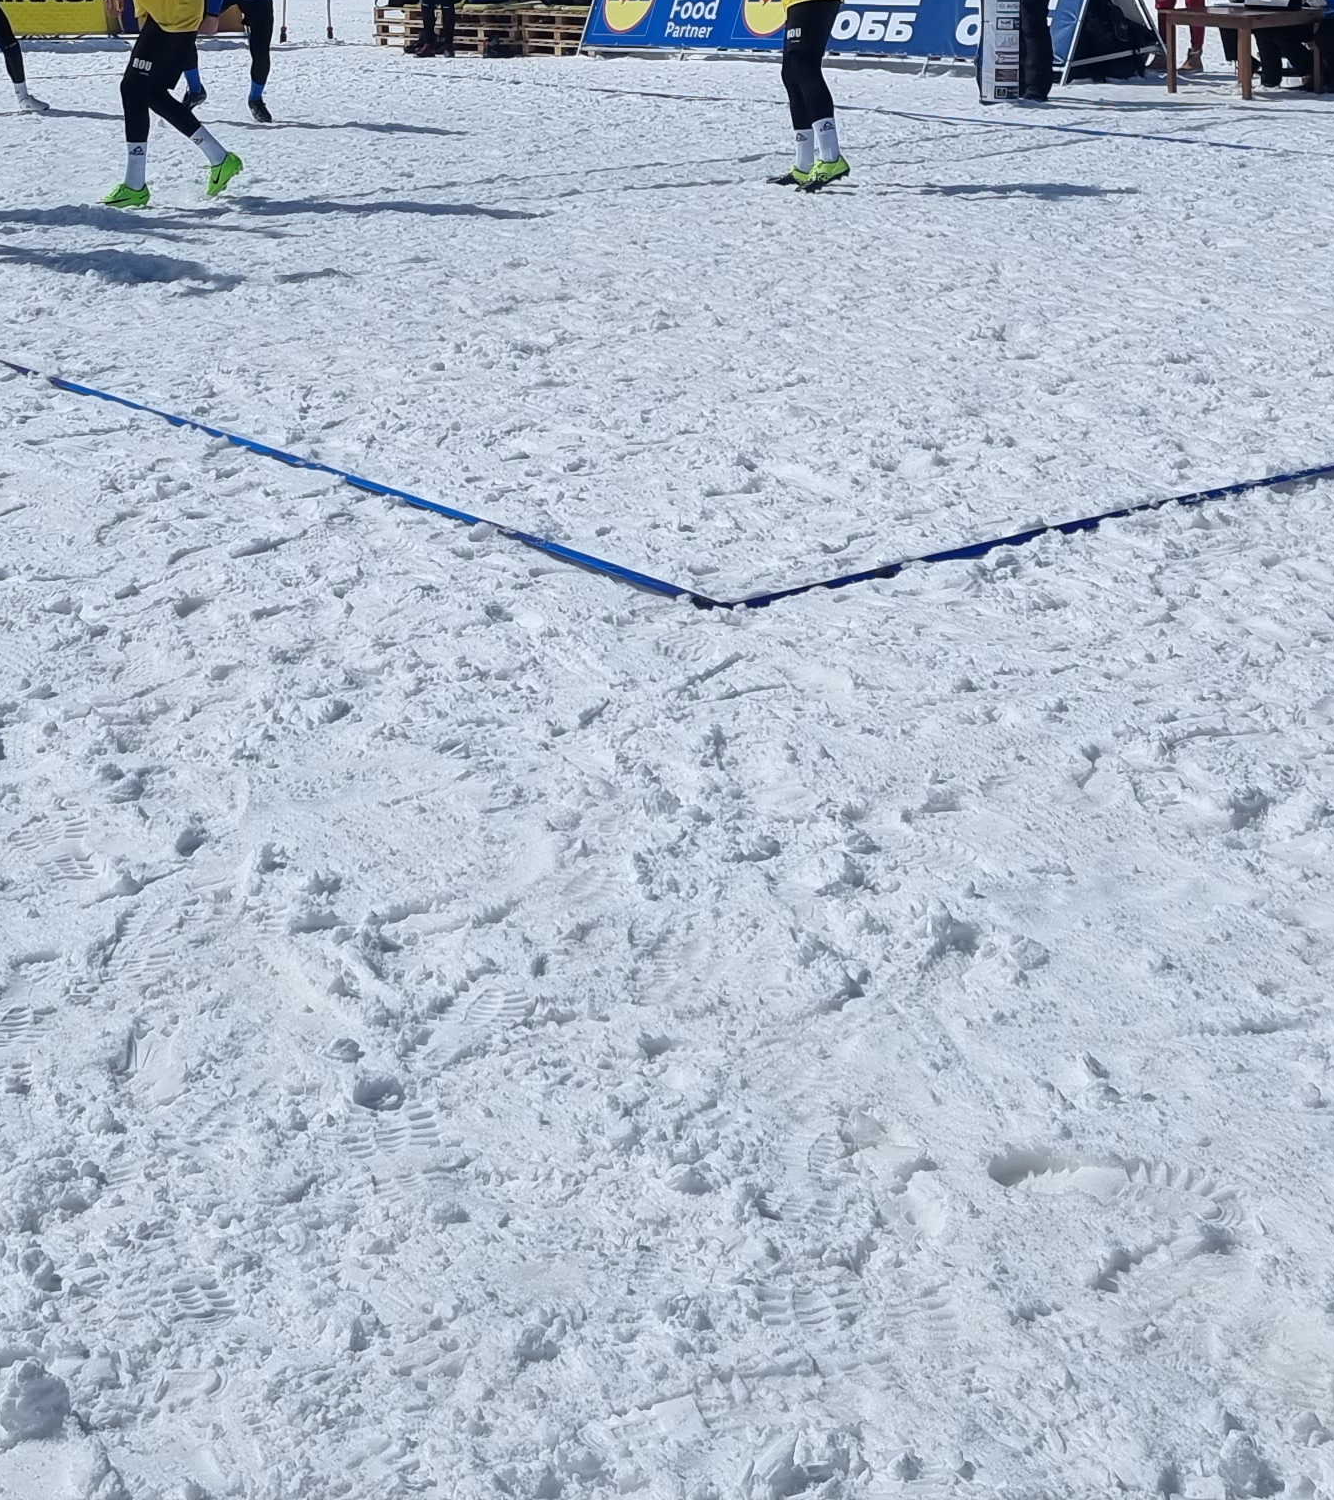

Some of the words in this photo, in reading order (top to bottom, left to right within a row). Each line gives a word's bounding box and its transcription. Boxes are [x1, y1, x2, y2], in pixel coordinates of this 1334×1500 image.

[664, 22, 713, 39] Partner
[830, 10, 917, 43] ОББ
[133, 58, 153, 71] ROU
